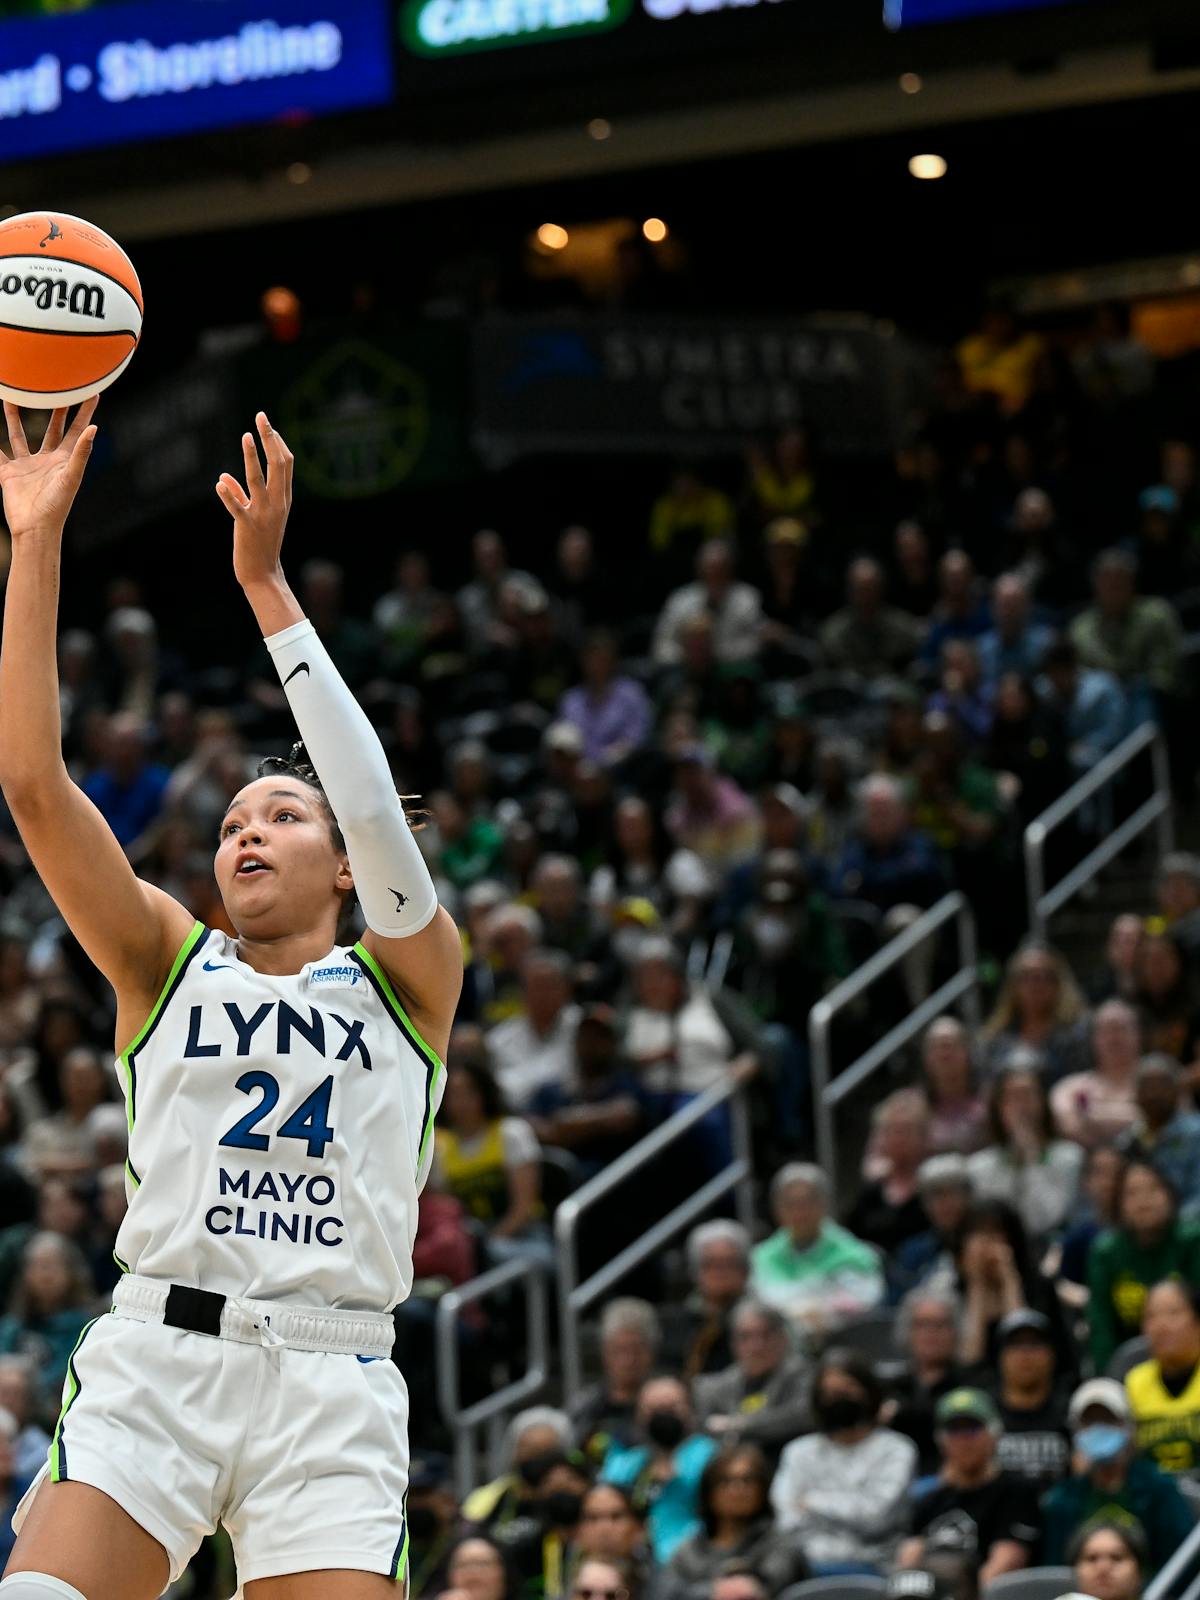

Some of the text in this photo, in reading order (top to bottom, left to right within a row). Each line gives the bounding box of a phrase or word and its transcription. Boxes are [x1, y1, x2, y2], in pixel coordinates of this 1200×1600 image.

[99, 20, 342, 101] Shoreline
[183, 999, 373, 1071] LYNX
[218, 1070, 335, 1159] 24
[219, 1167, 335, 1206] MAYO
[204, 1205, 344, 1247] CLINIC
